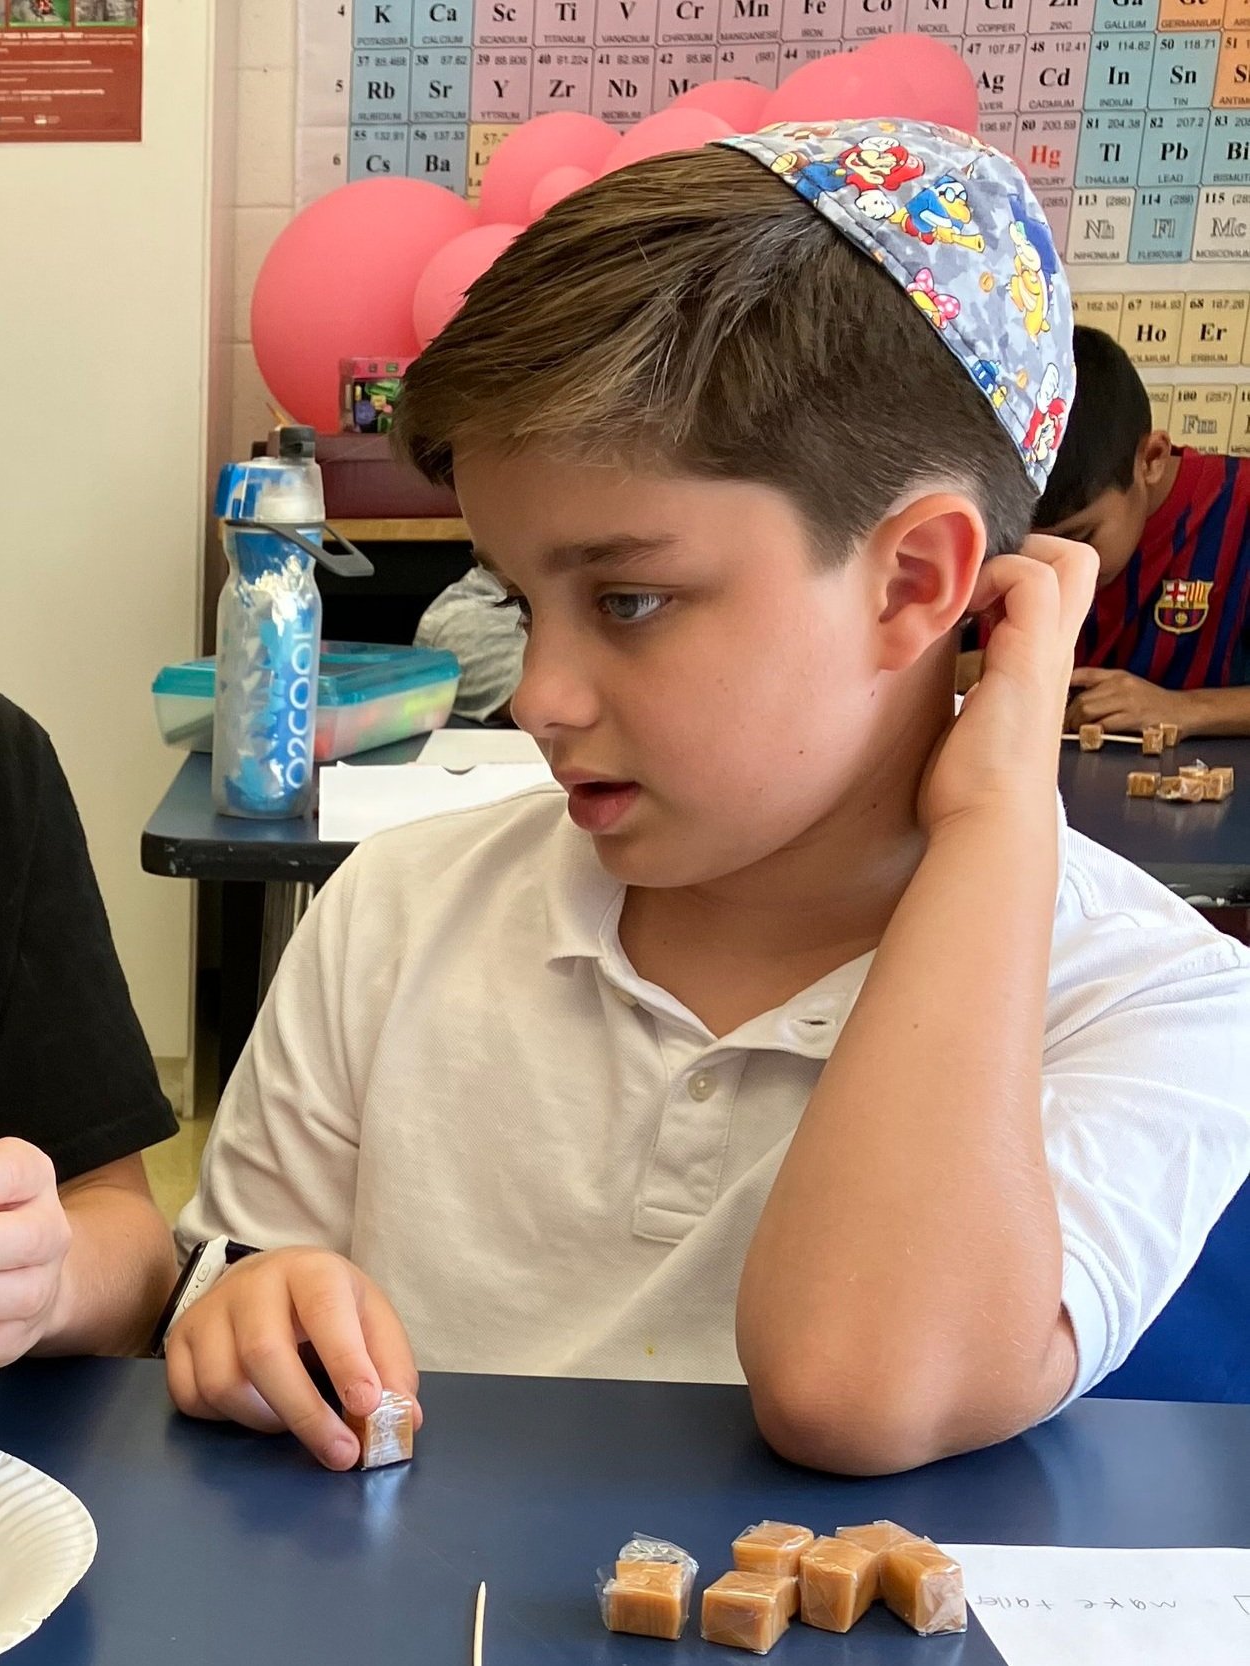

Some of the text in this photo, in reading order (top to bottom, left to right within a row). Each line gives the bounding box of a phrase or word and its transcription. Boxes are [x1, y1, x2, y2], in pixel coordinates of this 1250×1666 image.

[374, 5, 392, 24] K
[429, 3, 457, 22] Ca
[492, 4, 517, 22] Sc
[555, 2, 576, 21] Ti
[619, 1, 635, 20] V
[676, 1, 704, 20] Cr
[734, 0, 769, 18] Mn
[856, 24, 892, 35] COBALT
[917, 23, 949, 33] NICKEL
[976, 23, 1016, 33] COPPER
[1049, 21, 1072, 31] ZINC
[1104, 20, 1146, 29] GALLIUM
[1161, 19, 1221, 28] GERMANIUM
[967, 43, 1021, 54] 47 107.87
[1030, 41, 1087, 52] 48 112.41
[1095, 40, 1151, 51] 49 114.82
[1159, 38, 1216, 50] 50 118.71
[1225, 37, 1238, 49] 51
[476, 54, 491, 66] 39
[598, 54, 610, 65] 41
[659, 53, 673, 65] 42
[721, 52, 735, 63] 43
[784, 48, 798, 60] 44
[357, 56, 370, 67] 37
[415, 56, 429, 66] 38
[1039, 67, 1071, 87] Cd
[1108, 66, 1130, 85] In
[1170, 65, 1197, 85] Sn
[368, 81, 395, 100] Rb
[429, 80, 453, 99] Sr
[493, 80, 509, 98] Y
[549, 79, 576, 98] Zr
[608, 79, 638, 98] Nb
[1029, 99, 1075, 109] CADMIUM
[1099, 98, 1133, 108] INDIUM
[1173, 97, 1189, 106] TIN
[1021, 120, 1036, 131] 80
[1086, 118, 1141, 129] 81 204.38
[1150, 117, 1205, 128] 82 207.2
[1214, 115, 1229, 127] 83
[354, 131, 367, 141] 55
[414, 131, 427, 141] 56
[1030, 145, 1062, 168] Hg
[1099, 143, 1121, 162] Tl
[1161, 142, 1189, 161] Pb
[366, 156, 391, 173] Cs
[425, 155, 451, 173] Ba
[1085, 175, 1130, 185] THALLIUM
[1158, 174, 1184, 184] LEAD
[1078, 194, 1098, 206] 113
[1141, 193, 1161, 205] 114
[1204, 192, 1225, 204] 115
[1083, 219, 1115, 241] Nh
[1152, 217, 1175, 239] Fl
[1210, 217, 1247, 238] Mc
[1128, 300, 1142, 311] 67
[1190, 298, 1204, 309] 68
[1137, 324, 1167, 343] Ho
[1199, 322, 1228, 342] Er
[1191, 353, 1228, 363] ERBIUM
[1177, 391, 1197, 401] 100
[1183, 414, 1217, 435] Fm
[1073, 1597, 1176, 1613] make
